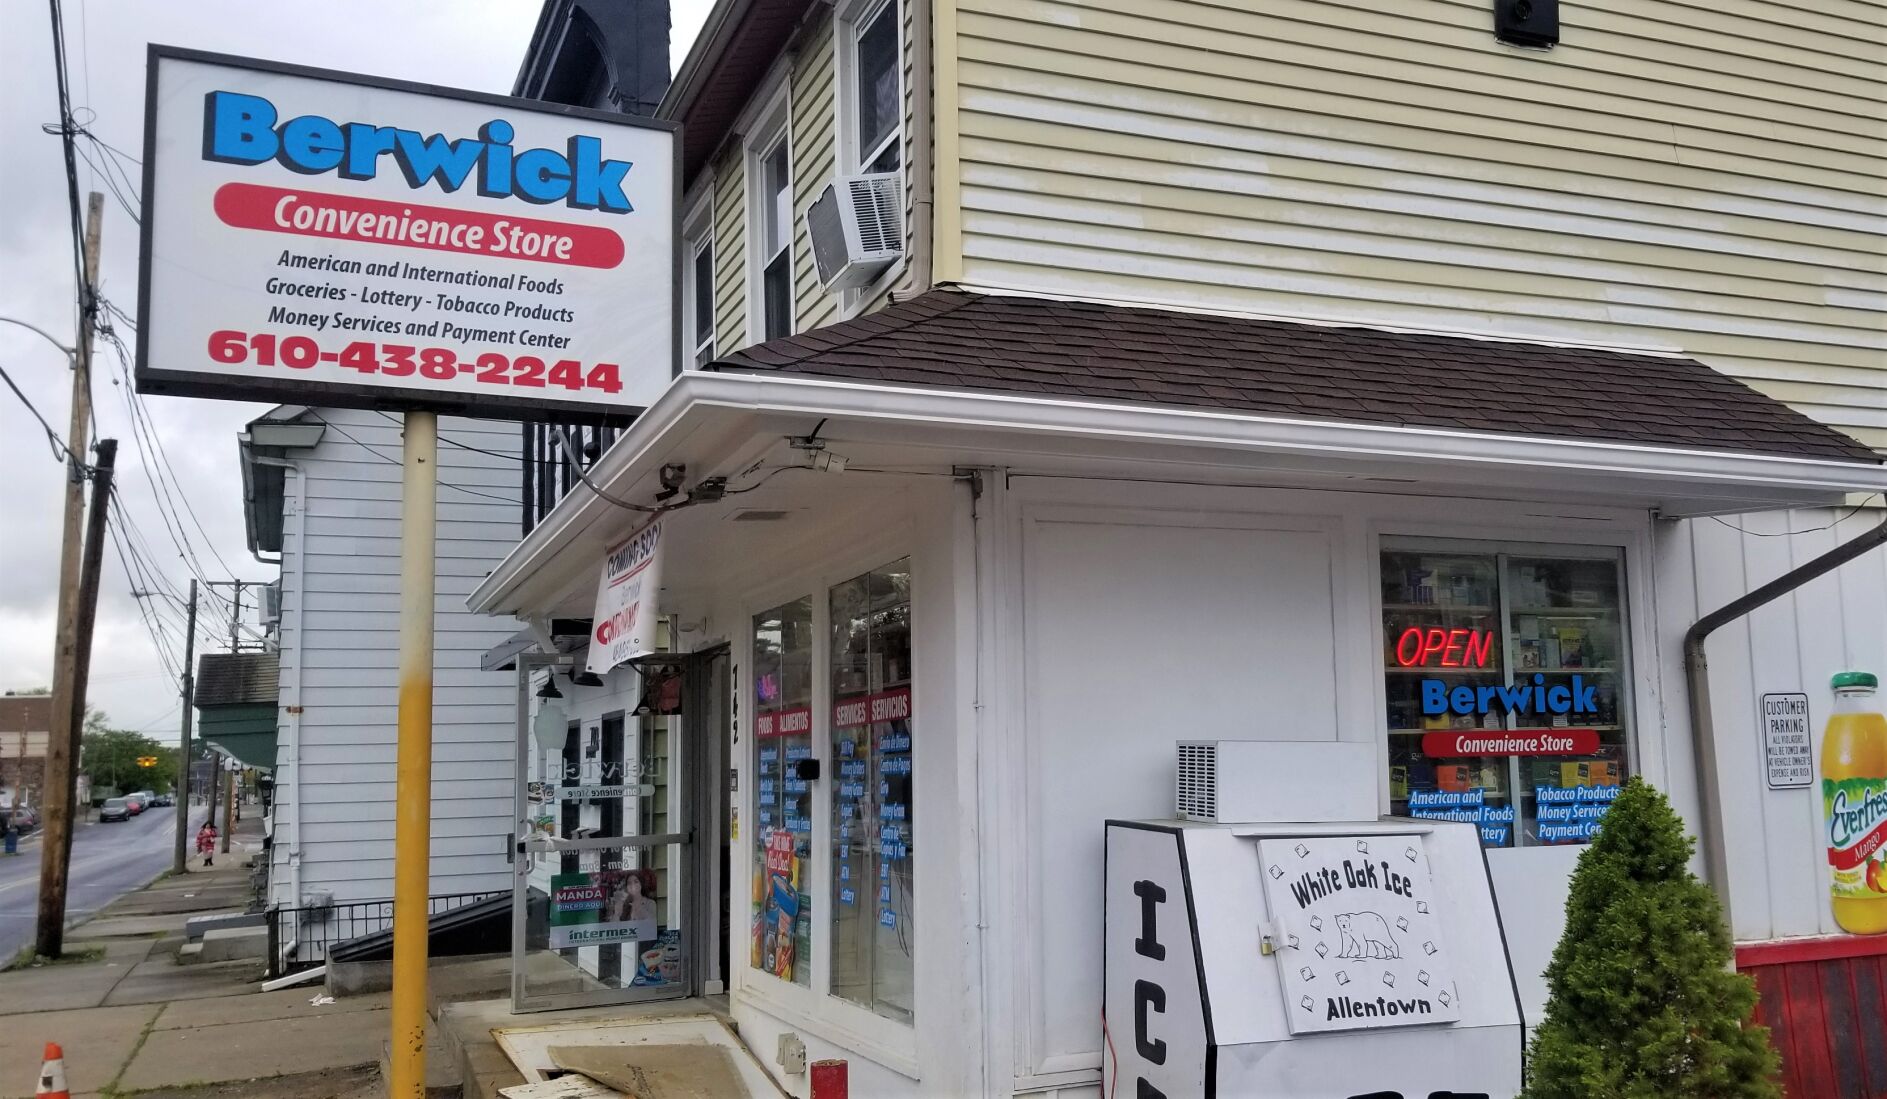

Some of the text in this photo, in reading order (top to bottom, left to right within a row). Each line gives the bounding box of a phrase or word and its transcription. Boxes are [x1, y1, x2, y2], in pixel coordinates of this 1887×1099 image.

[202, 89, 635, 215] Berwick
[273, 193, 574, 260] Convenience Store
[278, 249, 565, 296] American and International Foods
[265, 276, 346, 302] Groceries
[361, 284, 422, 312] Lottery
[436, 292, 500, 317] Tobacco
[504, 299, 574, 324] Products
[268, 306, 572, 350] Money Services and Payment Center
[207, 329, 623, 394] 610-438-2244
[608, 539, 639, 580] COMING
[1397, 626, 1493, 668] OPEN
[1421, 672, 1598, 716] Berwick
[836, 694, 908, 726] SERVICES SERVICIOS
[1766, 700, 1806, 715] CUSTOMER
[758, 711, 809, 735] FOODS ALIMENTOS
[1770, 718, 1804, 733] PARKING
[1455, 733, 1574, 755] Convenience Store
[1785, 746, 1799, 755] TOWED
[1771, 767, 1809, 778] EXPENSE AND RISK
[1774, 757, 1792, 766] VEHICLE
[1410, 789, 1483, 805] American and
[1536, 785, 1620, 801] Tobacco Products
[1484, 807, 1514, 822] Foods
[1537, 803, 1607, 823] Money Service
[1831, 788, 1887, 847] Everfres
[1539, 823, 1583, 841] Payment
[1855, 831, 1881, 861] Mango
[556, 889, 603, 902] MANDA
[1289, 859, 1413, 910] White Oak Ice
[569, 926, 638, 941] intermex
[1133, 879, 1167, 1099] IC
[1326, 997, 1432, 1022] Allentown
